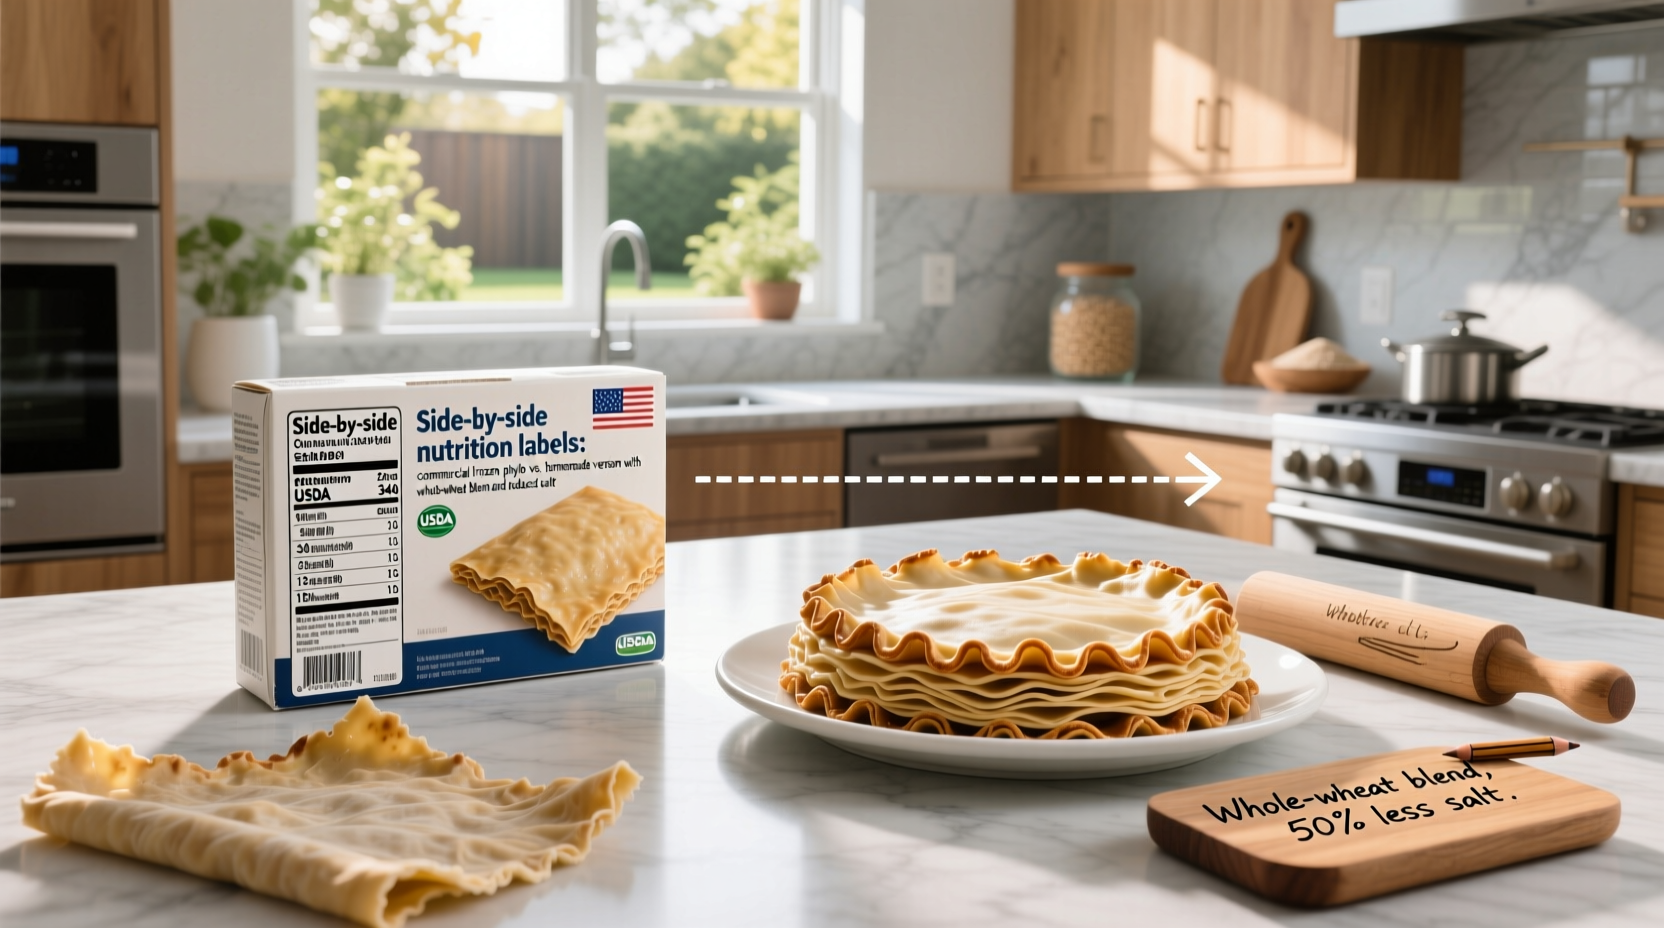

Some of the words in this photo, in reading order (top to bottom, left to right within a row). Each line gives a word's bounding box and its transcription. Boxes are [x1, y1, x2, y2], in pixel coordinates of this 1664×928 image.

[293, 412, 397, 437] Side-by-side
[416, 403, 548, 436] Side-by-side
[417, 435, 513, 463] nutrition
[518, 430, 586, 457] labels:
[294, 487, 332, 502] USDA
[378, 484, 399, 496] 340
[420, 512, 454, 527] USDA
[1202, 776, 1399, 823] Whole-wheat
[1401, 760, 1492, 789] blend,
[1288, 808, 1366, 841] 50%
[1370, 803, 1435, 825] less
